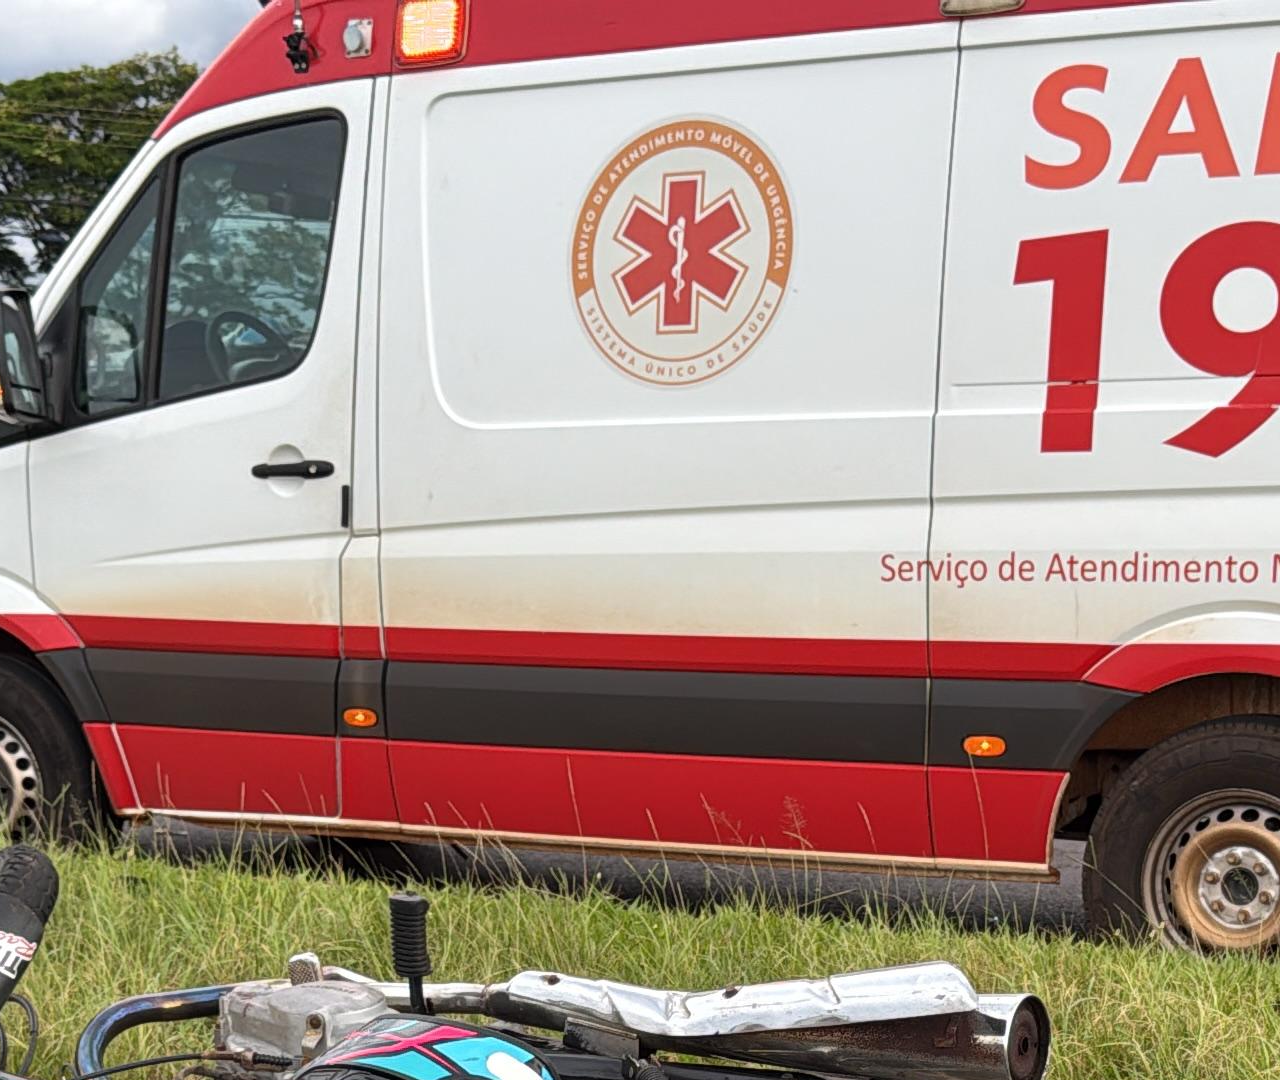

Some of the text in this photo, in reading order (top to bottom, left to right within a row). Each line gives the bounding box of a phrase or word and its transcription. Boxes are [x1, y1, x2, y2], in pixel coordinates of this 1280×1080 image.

[577, 128, 788, 280] SERVIÇO DE ATENDIMENTO MÓVEL DE URGÊNCIA
[586, 299, 772, 378] SISTEMA ÚNICO DE SAÚDE
[880, 552, 988, 588] Serviço
[998, 551, 1036, 582] de
[1044, 551, 1259, 583] Atendimento
